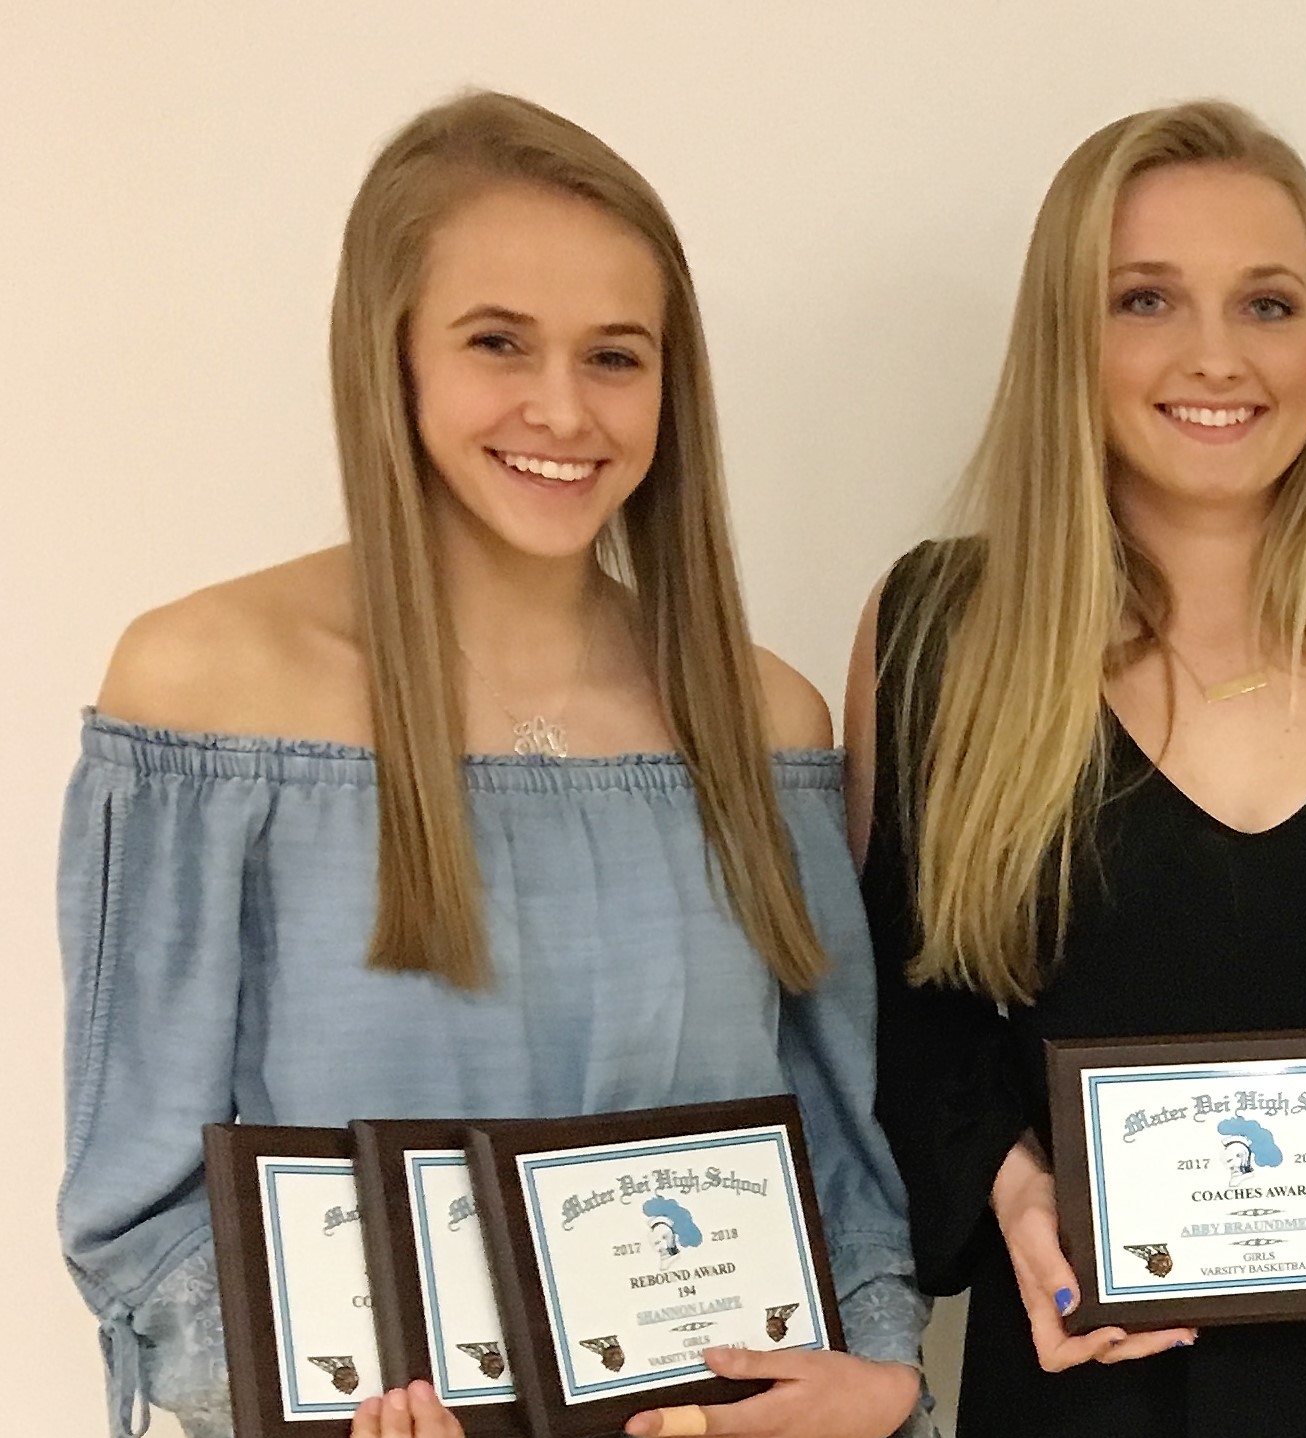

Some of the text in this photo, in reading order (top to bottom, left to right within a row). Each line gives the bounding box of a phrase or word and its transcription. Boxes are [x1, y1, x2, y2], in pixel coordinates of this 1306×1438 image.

[1123, 1106, 1188, 1143] Mater
[1191, 1094, 1231, 1123] Dei
[1234, 1091, 1290, 1117] High
[1177, 1158, 1210, 1170] 2017
[653, 1168, 699, 1199] High
[701, 1166, 768, 1197] School
[1191, 1188, 1262, 1202] COACHES
[711, 1228, 739, 1241] 2018
[1181, 1223, 1220, 1237] ABBY
[612, 1242, 641, 1256] 2017
[1243, 1251, 1275, 1262] GIRLS
[629, 1262, 736, 1289] REBOUND AWARD
[1200, 1264, 1246, 1276] VARSITY
[677, 1285, 697, 1298] 194
[637, 1303, 697, 1324] SHANNON
[683, 1335, 710, 1347] GIRLS
[648, 1352, 688, 1367] VARSITY
